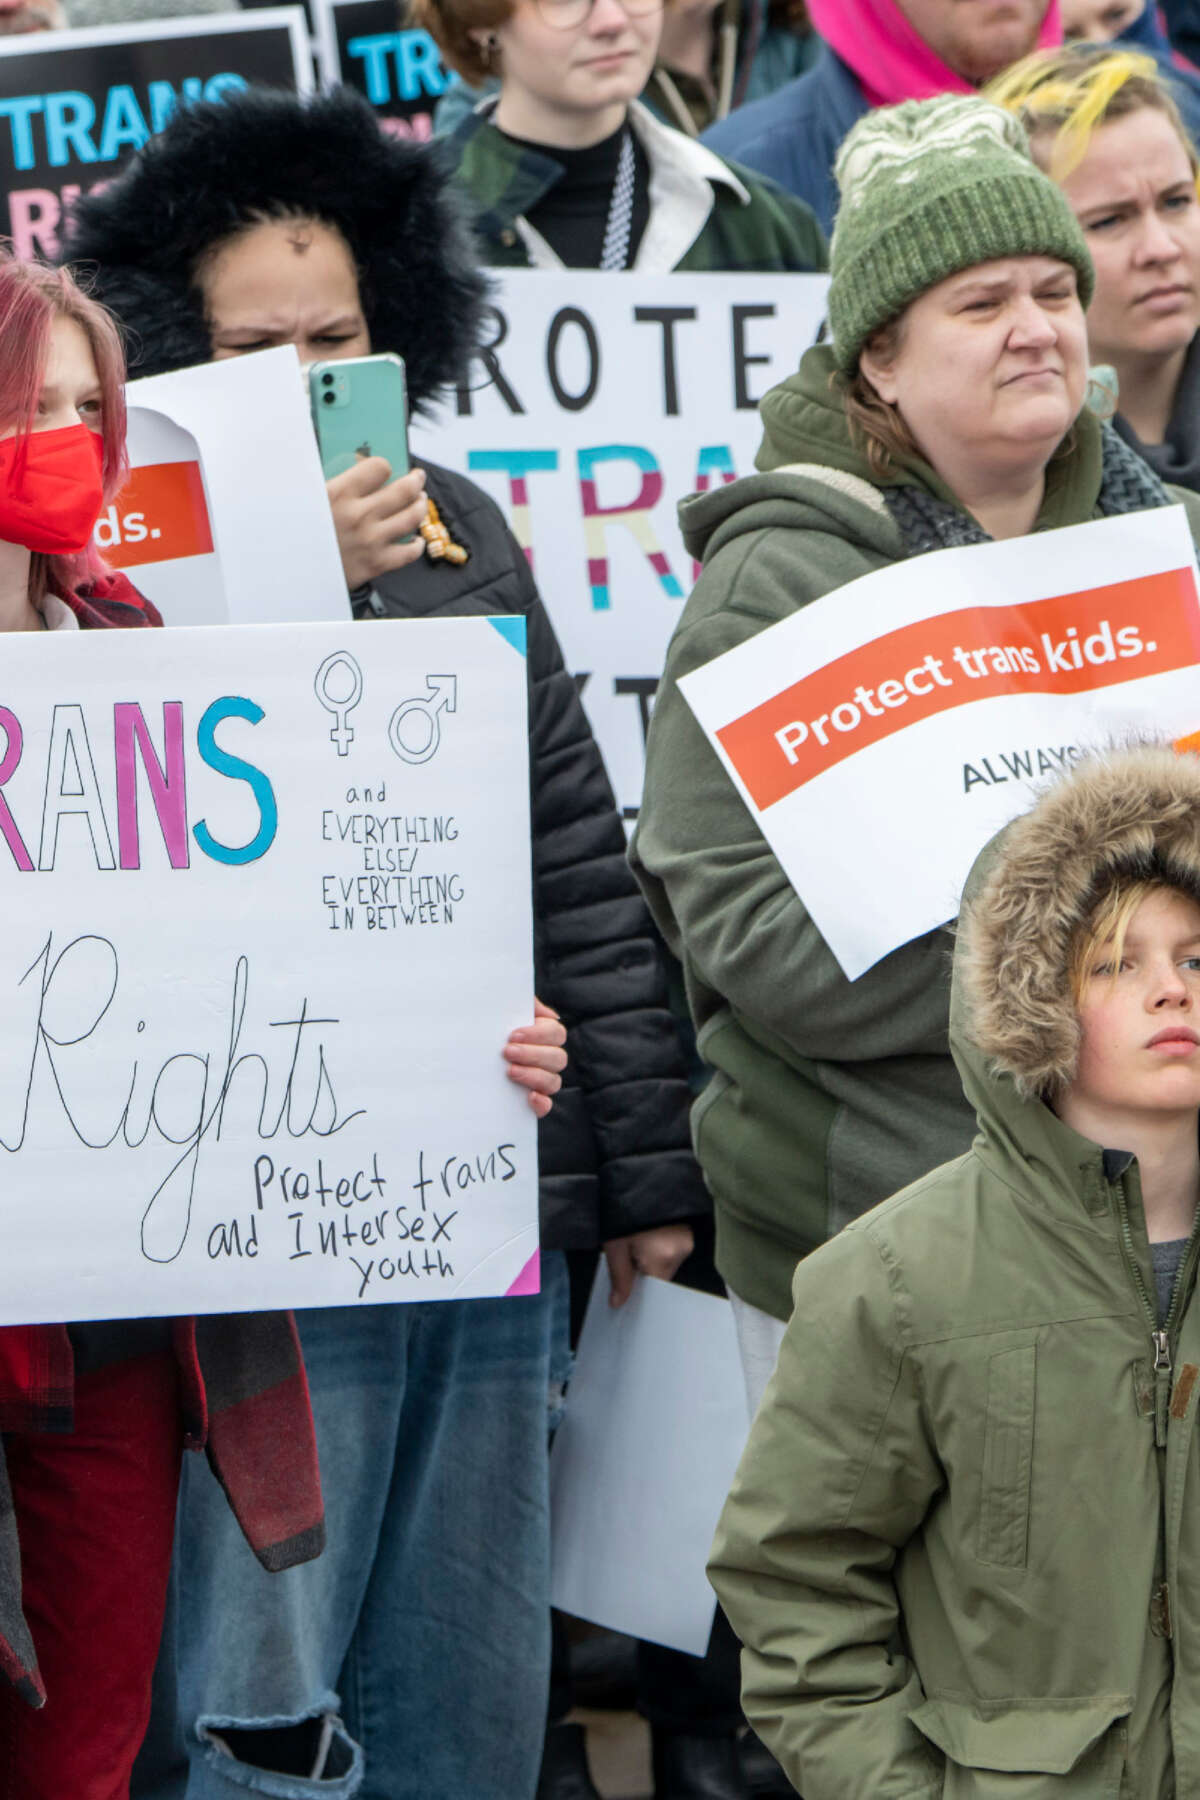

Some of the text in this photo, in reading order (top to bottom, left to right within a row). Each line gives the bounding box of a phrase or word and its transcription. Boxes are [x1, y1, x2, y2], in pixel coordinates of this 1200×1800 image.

[347, 28, 461, 105] TR
[456, 303, 832, 416] ROTE
[774, 620, 1158, 766] Protect trans kids.
[346, 782, 386, 803] and
[322, 810, 459, 844] EVERYTHING
[322, 873, 464, 905] EVERYTHING
[328, 904, 453, 930] IN BETWEEN
[254, 1144, 517, 1211] Protect trans
[207, 1206, 459, 1260] and Intersex
[350, 1250, 455, 1298] youth
